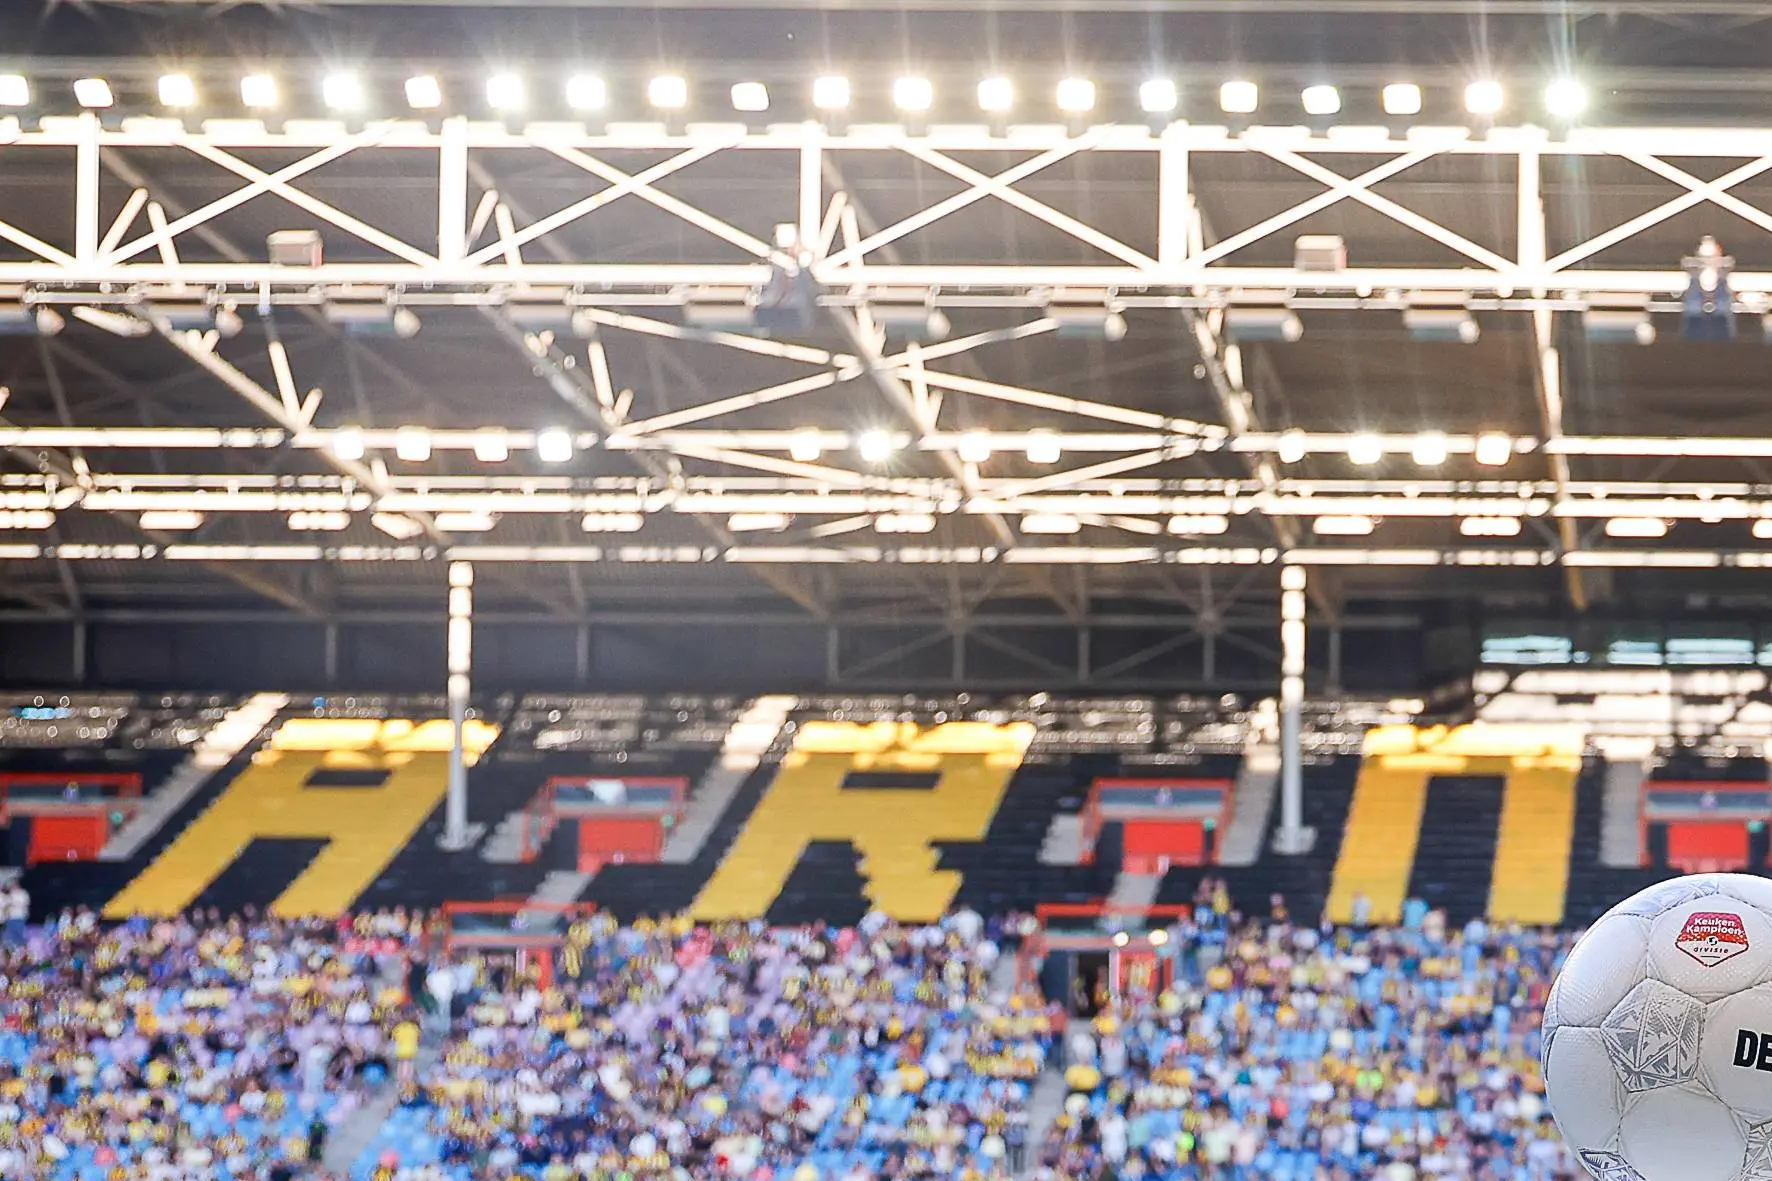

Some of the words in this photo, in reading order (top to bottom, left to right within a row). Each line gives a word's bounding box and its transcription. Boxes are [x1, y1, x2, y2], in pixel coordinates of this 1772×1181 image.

[1694, 917, 1736, 928] Keuken
[1686, 924, 1742, 936] Kampioen
[1693, 946, 1729, 954] divisie
